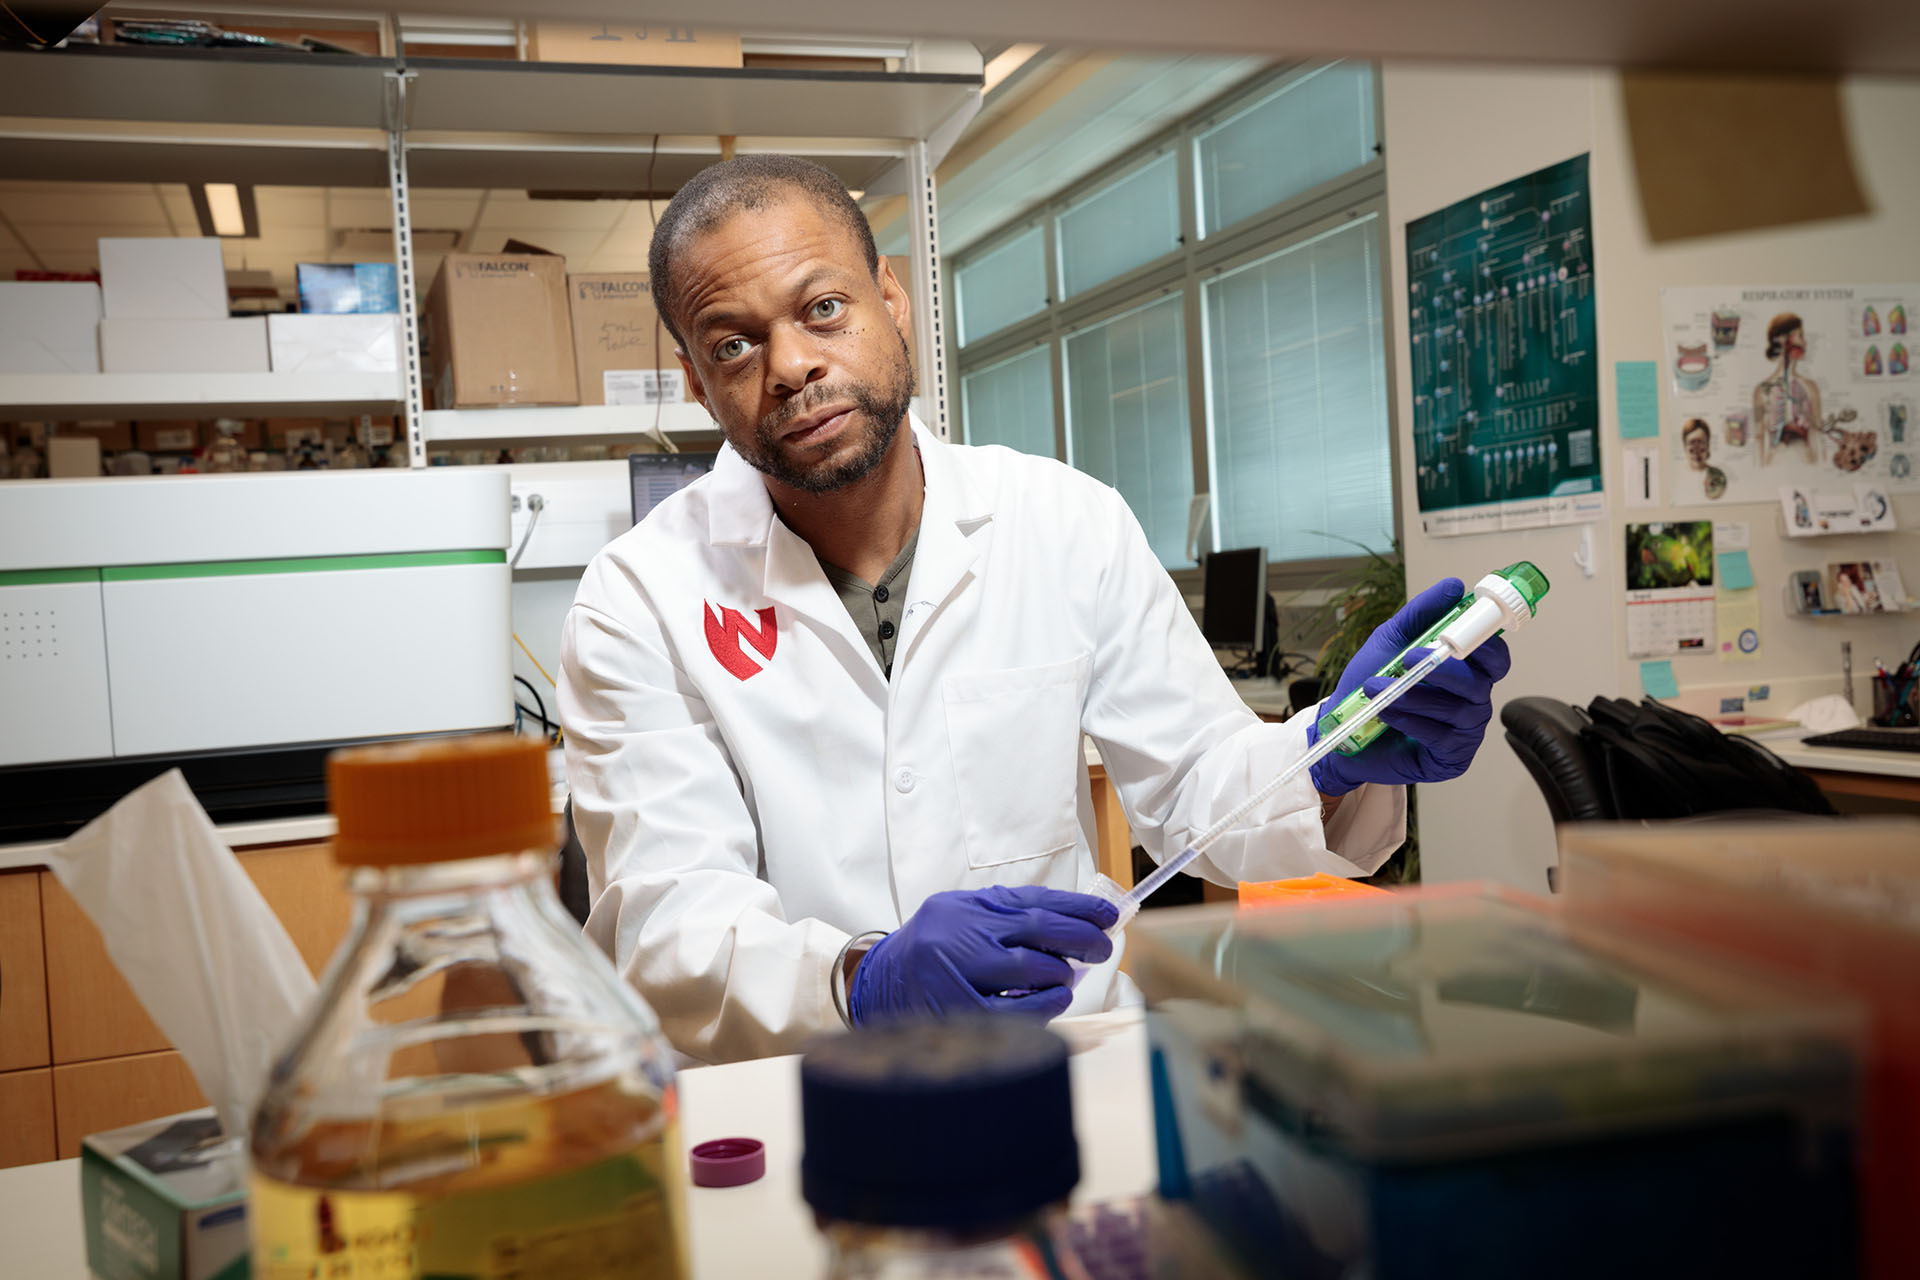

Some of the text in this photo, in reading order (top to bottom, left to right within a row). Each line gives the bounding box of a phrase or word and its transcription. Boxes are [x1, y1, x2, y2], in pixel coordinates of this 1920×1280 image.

[478, 261, 529, 273] FALCON
[601, 281, 649, 293] FALCON
[1741, 290, 1810, 301] RESPIRATORY
[1813, 289, 1854, 300] SYSTEM
